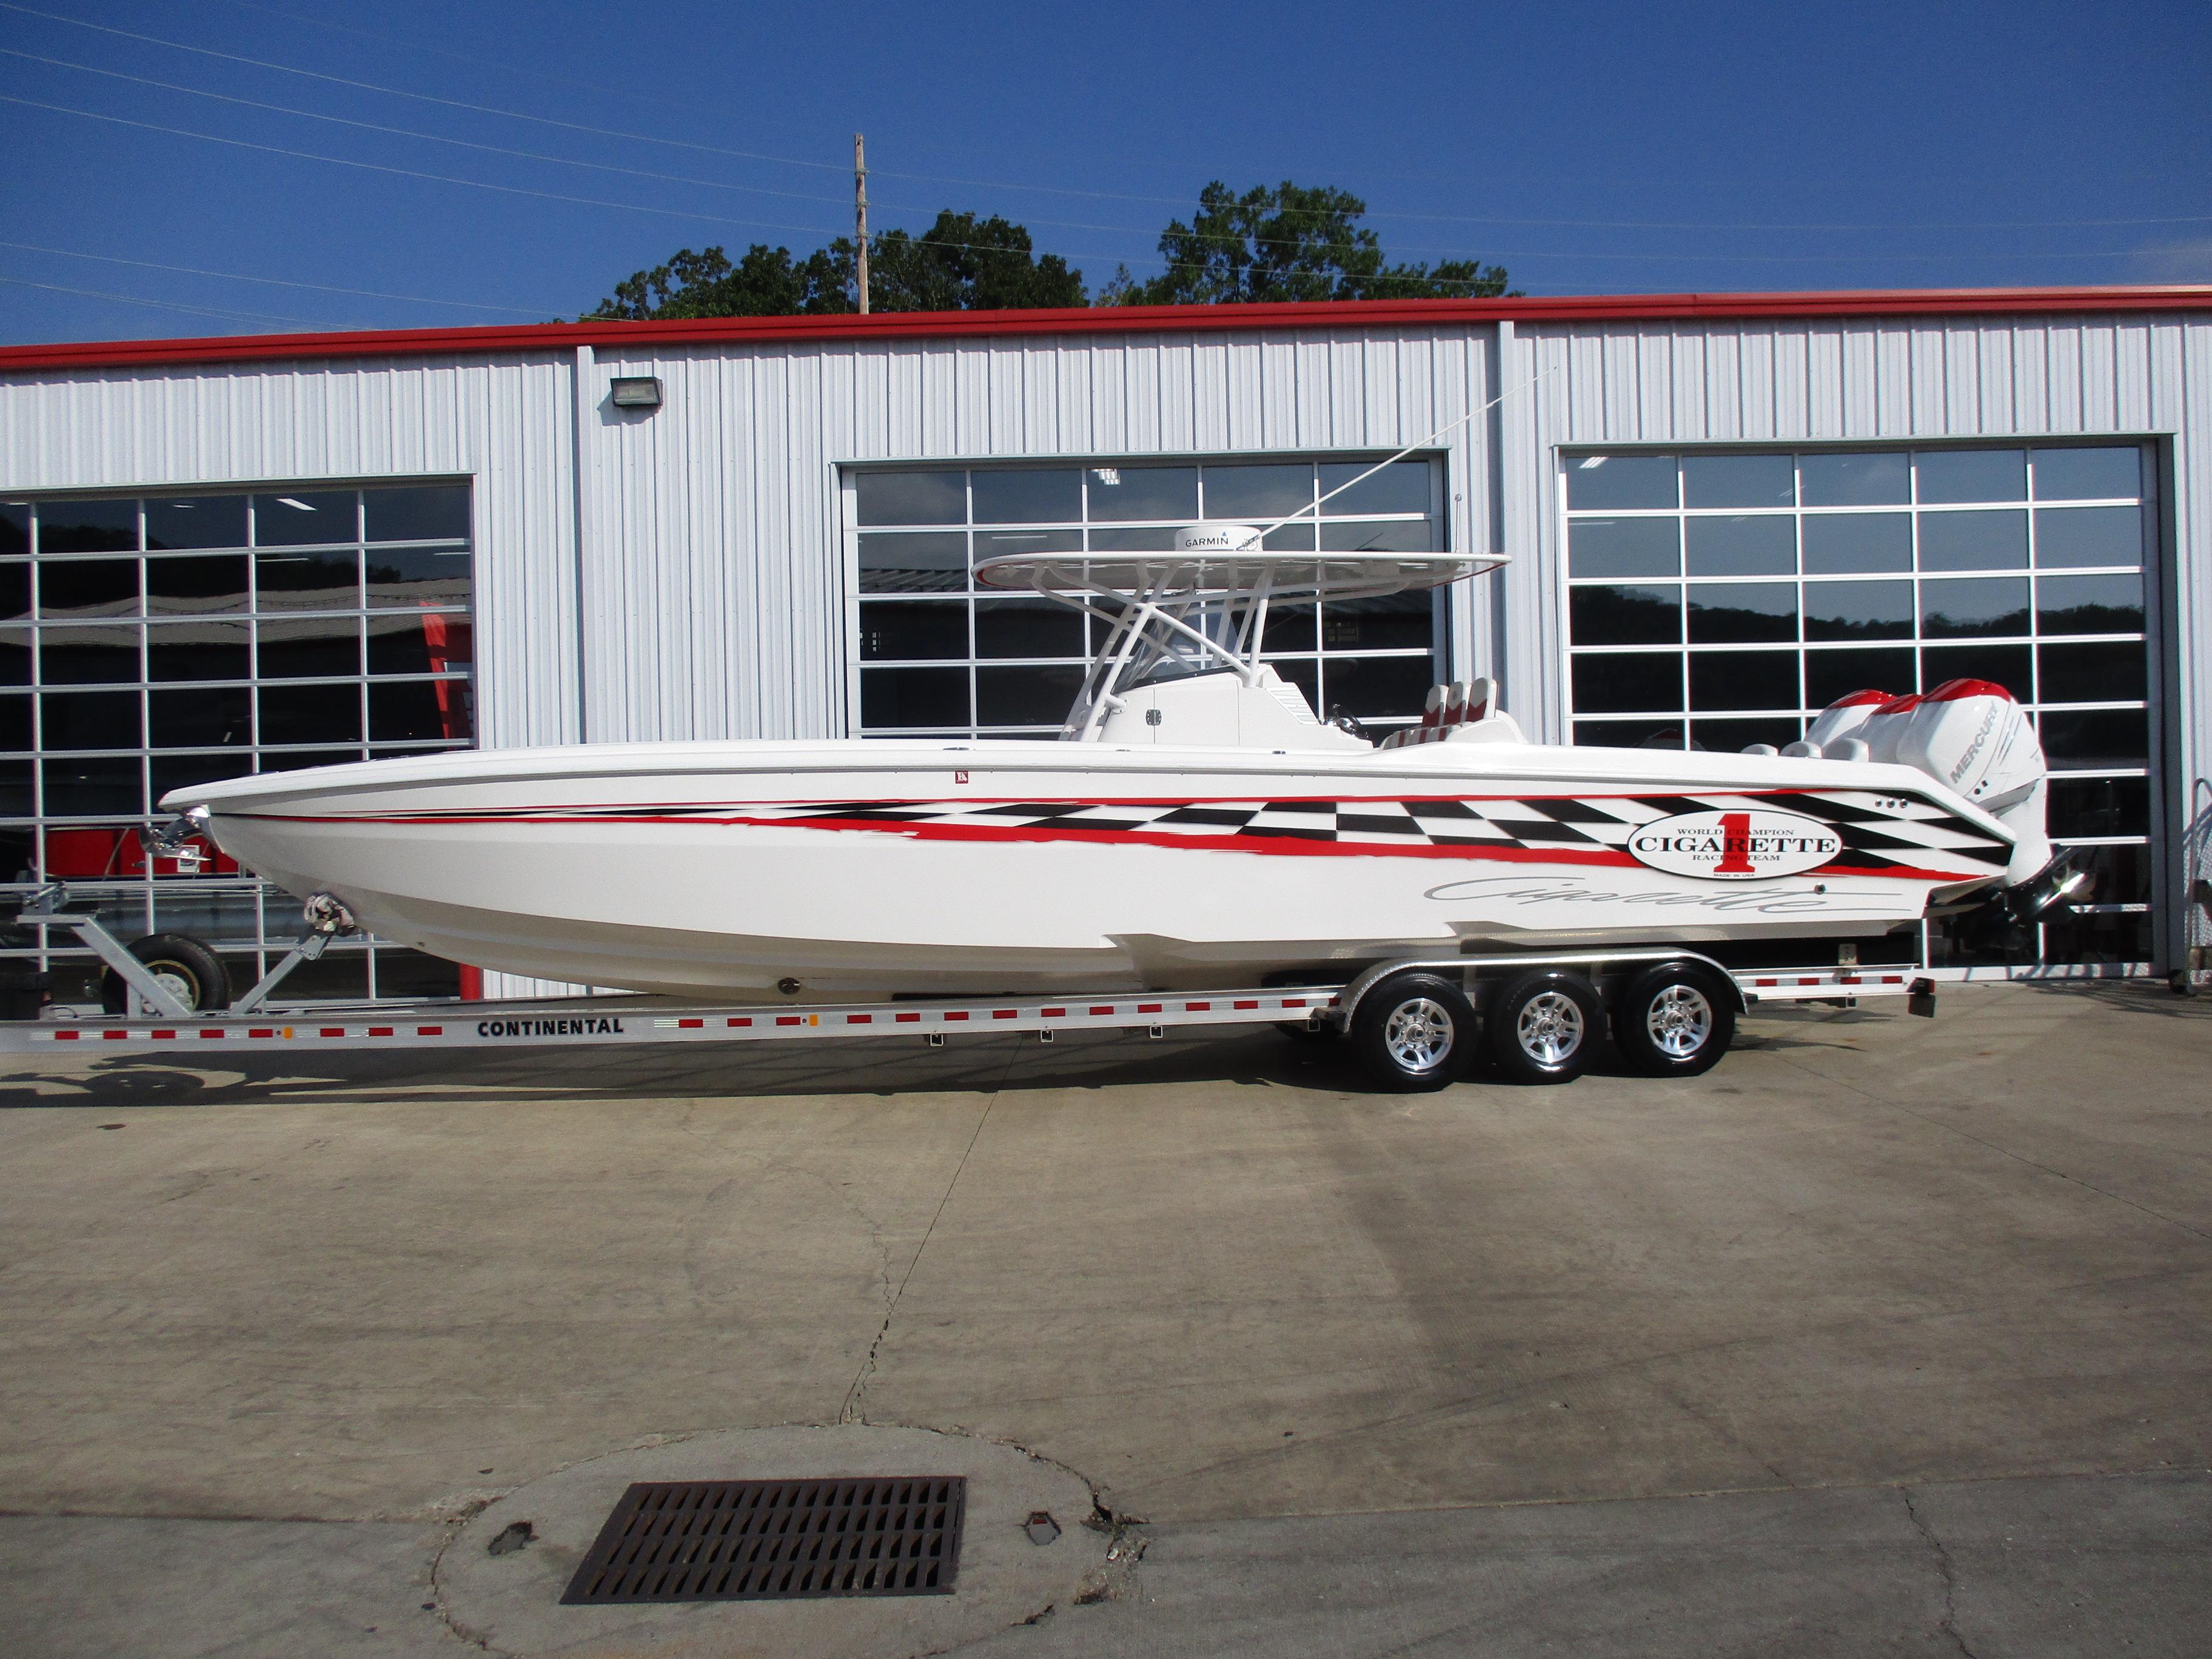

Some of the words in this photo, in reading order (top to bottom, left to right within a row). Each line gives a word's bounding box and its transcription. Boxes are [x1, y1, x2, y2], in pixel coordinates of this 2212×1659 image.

[1185, 538, 1228, 547] GARMIN
[1635, 837, 1836, 853] CIGARETTE
[1714, 813, 1755, 873] 1
[477, 1018, 624, 1036] CONTINENTAL
